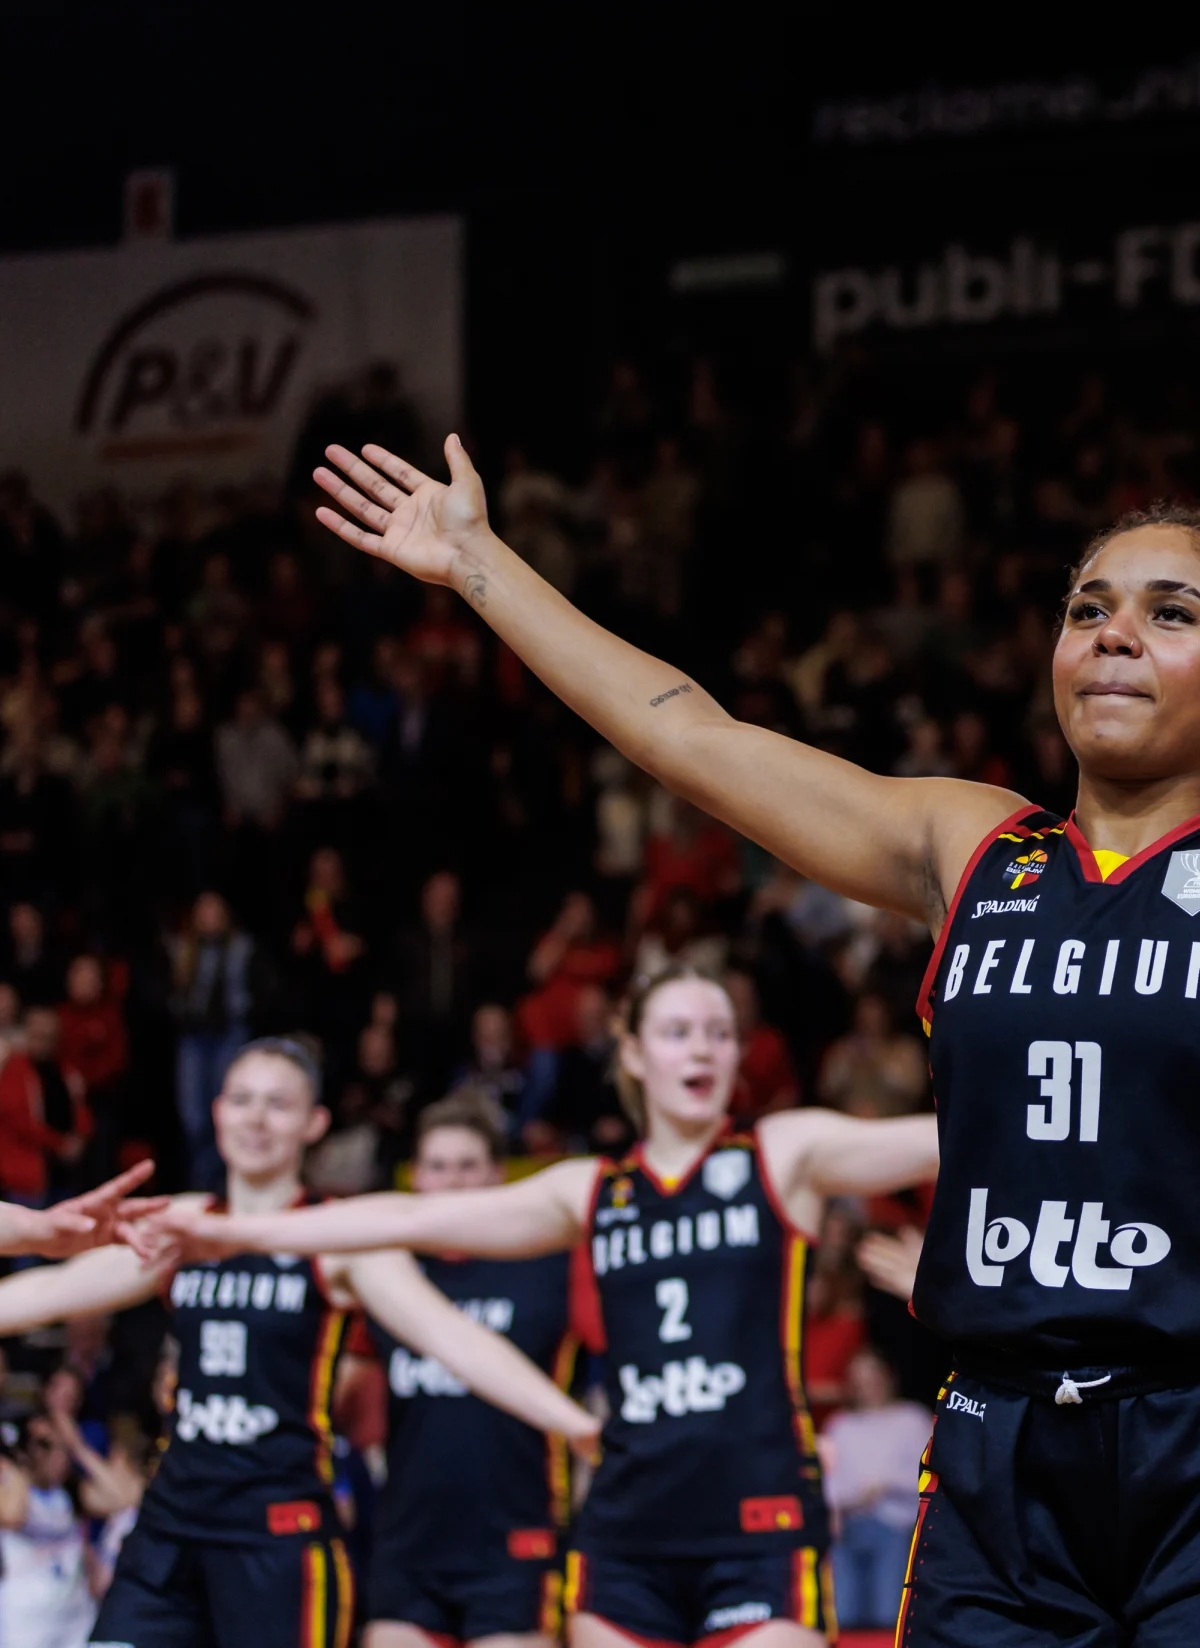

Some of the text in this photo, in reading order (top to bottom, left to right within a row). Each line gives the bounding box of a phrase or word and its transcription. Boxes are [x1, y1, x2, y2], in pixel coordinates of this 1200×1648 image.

[112, 336, 299, 428] P&V
[971, 894, 1041, 919] SPALDING
[1027, 1040, 1102, 1142] 31
[965, 1188, 1171, 1291] lotto
[655, 1277, 692, 1344] 2
[619, 1356, 747, 1424] lotto
